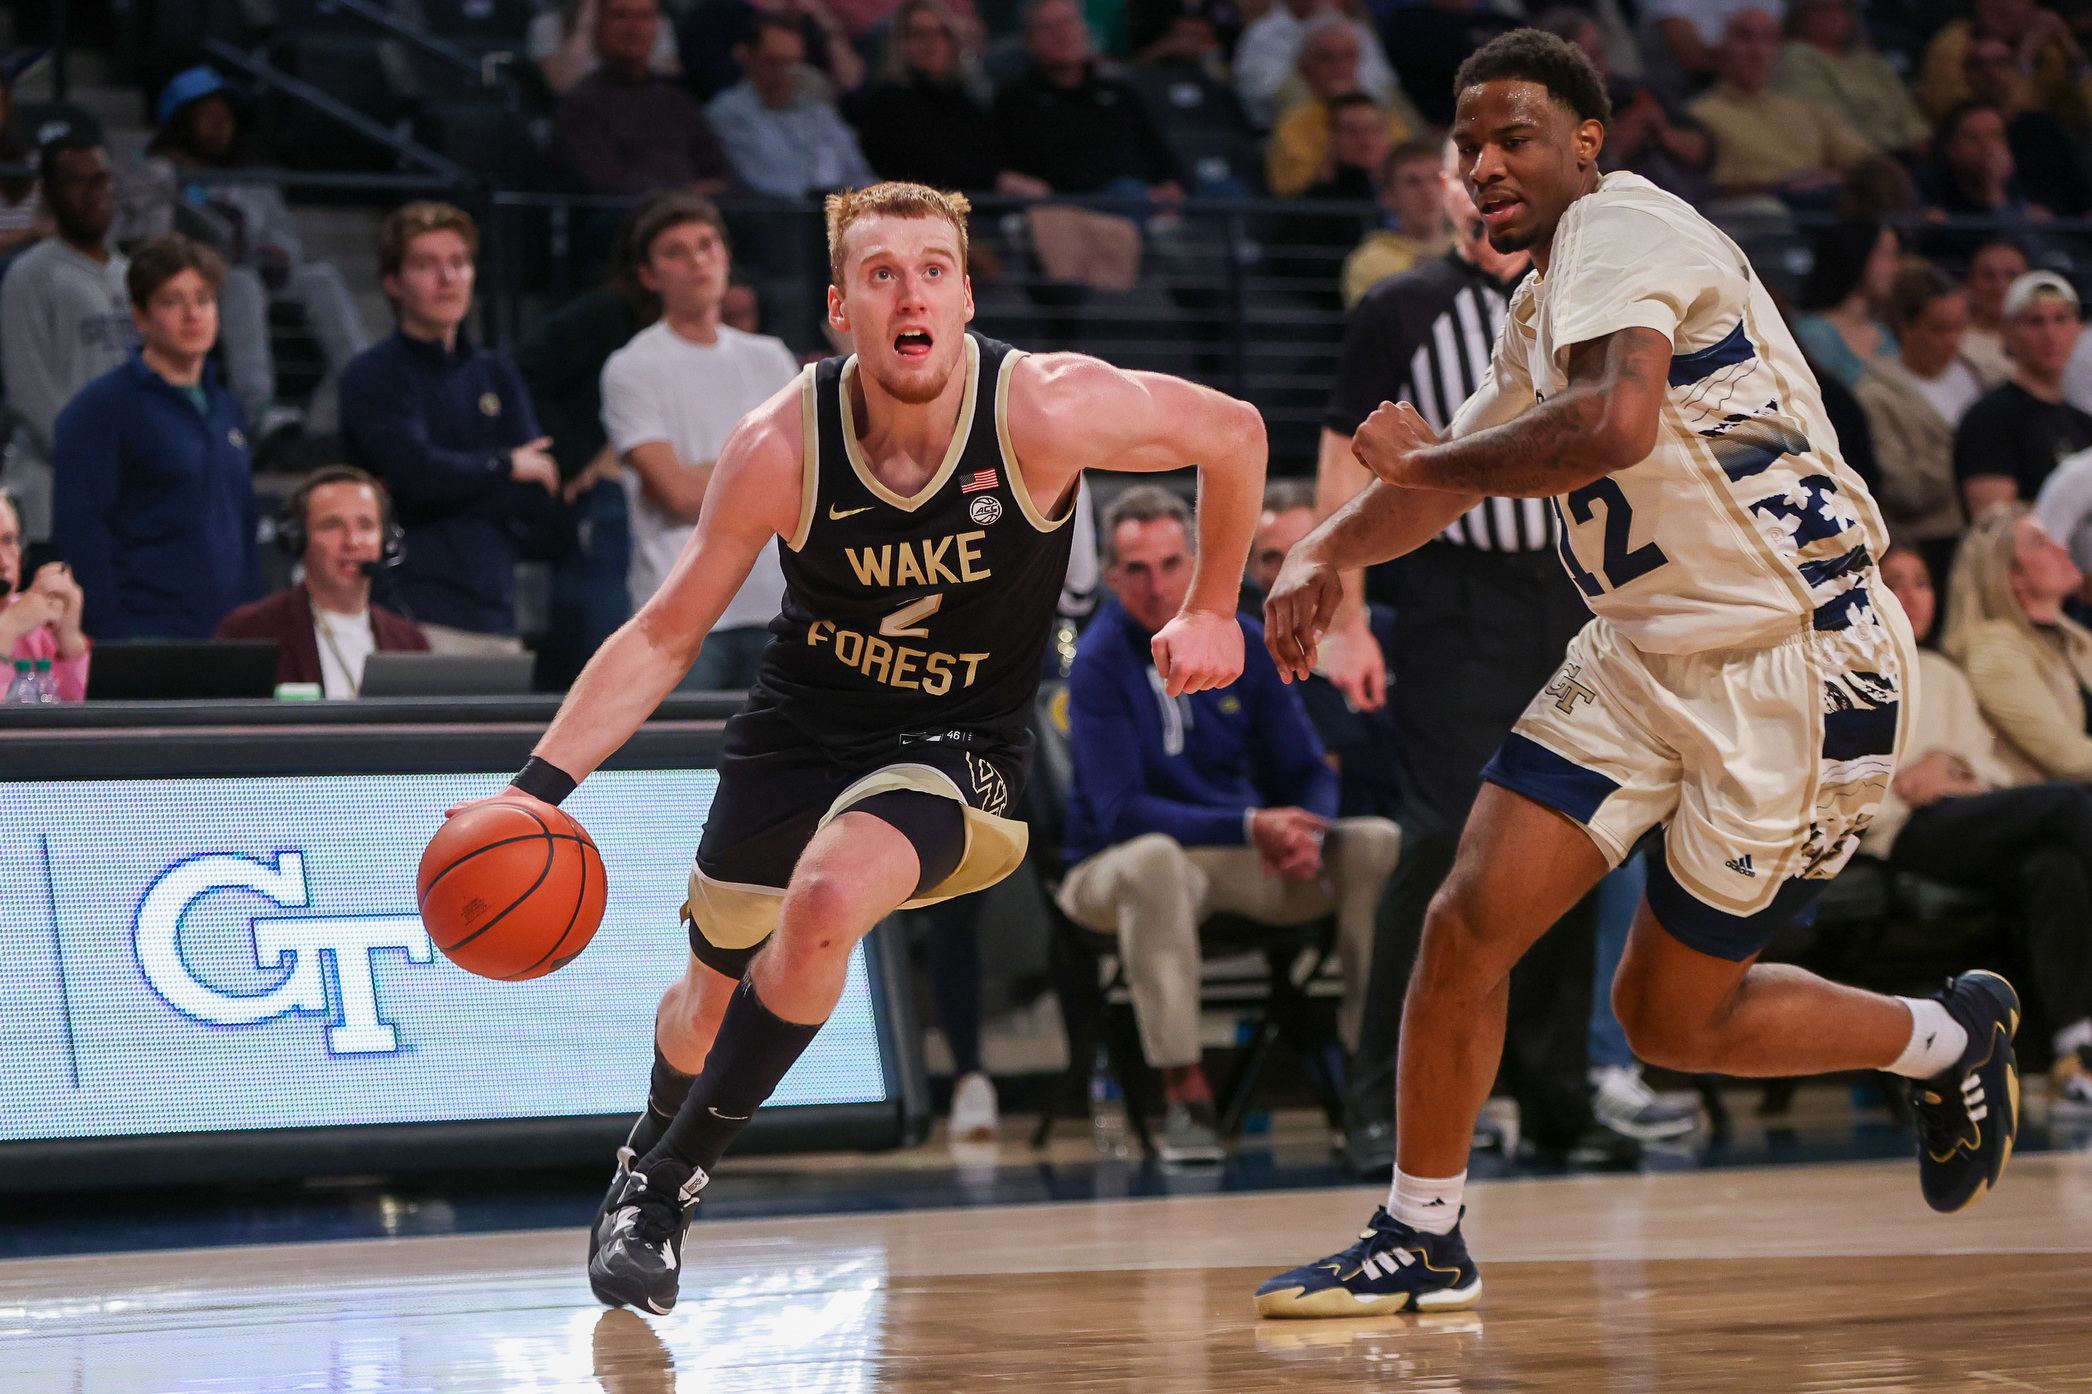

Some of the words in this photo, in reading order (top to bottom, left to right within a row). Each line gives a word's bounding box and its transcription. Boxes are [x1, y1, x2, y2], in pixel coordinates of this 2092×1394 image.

[844, 530, 992, 587] WAKE
[807, 620, 990, 697] FOREST
[946, 730, 961, 741] 46
[1725, 860, 1756, 878] adidas
